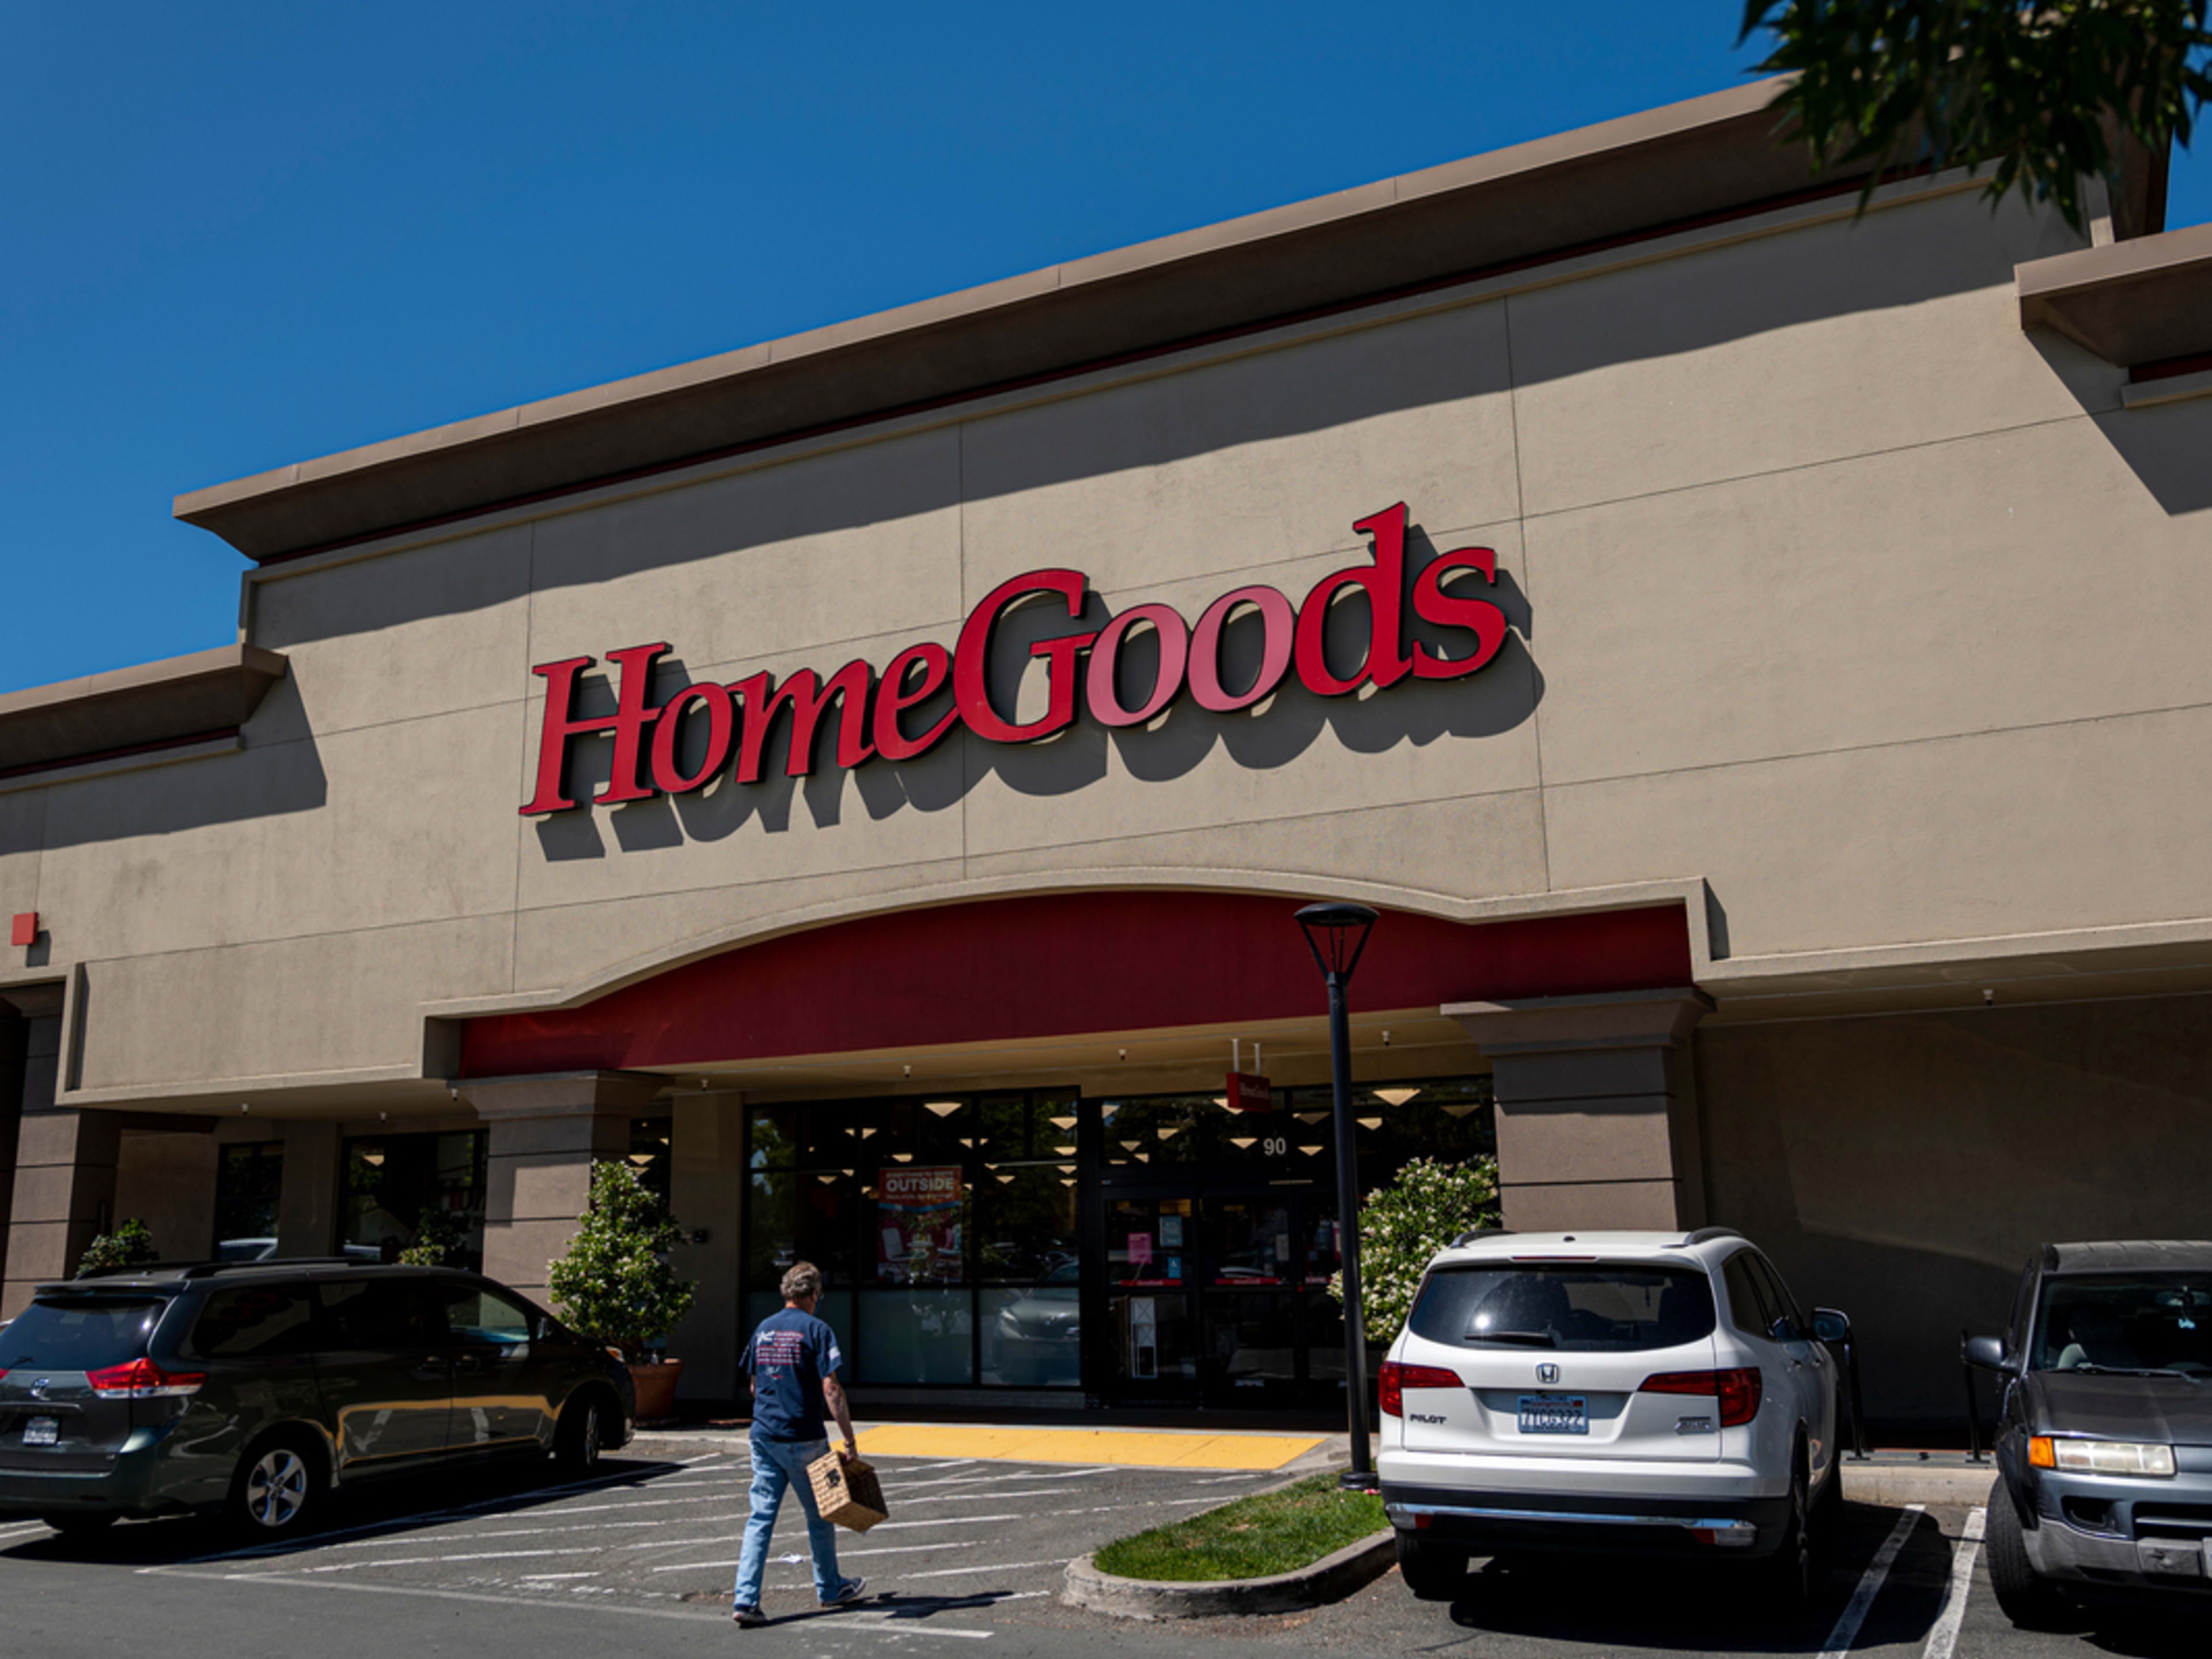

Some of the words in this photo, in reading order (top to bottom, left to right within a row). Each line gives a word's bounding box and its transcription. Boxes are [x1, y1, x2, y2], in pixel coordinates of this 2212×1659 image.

[519, 501, 1505, 815] HomeGoods
[1263, 1137, 1286, 1156] 90
[886, 1177, 954, 1192] OUTSIDE
[1410, 1414, 1447, 1424] PILOT
